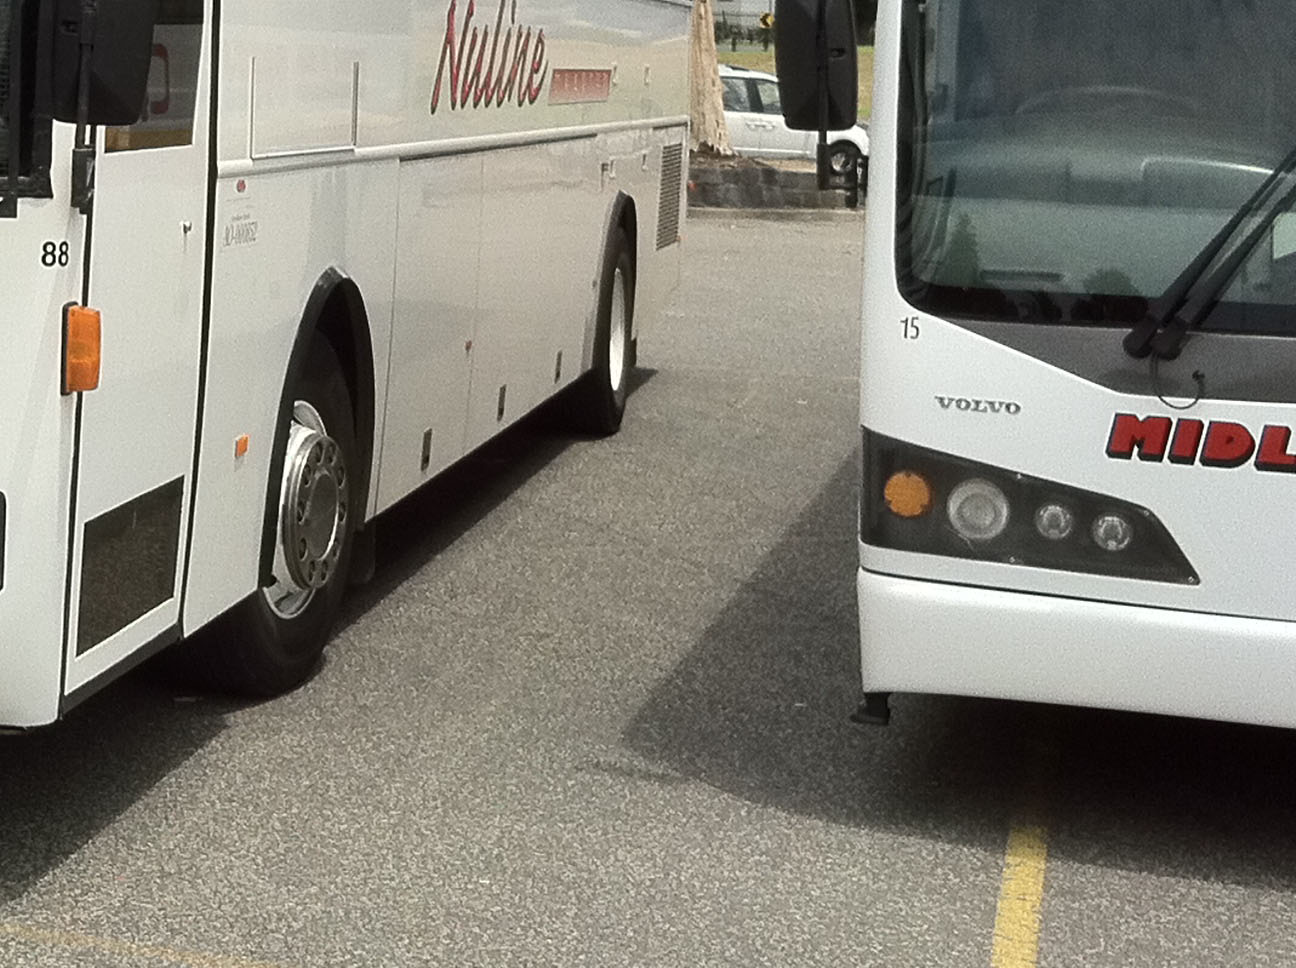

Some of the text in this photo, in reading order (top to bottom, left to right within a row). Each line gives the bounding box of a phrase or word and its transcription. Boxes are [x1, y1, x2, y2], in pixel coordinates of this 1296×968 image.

[41, 240, 69, 267] 88
[900, 317, 920, 339] 15
[934, 396, 1021, 414] VOLVO
